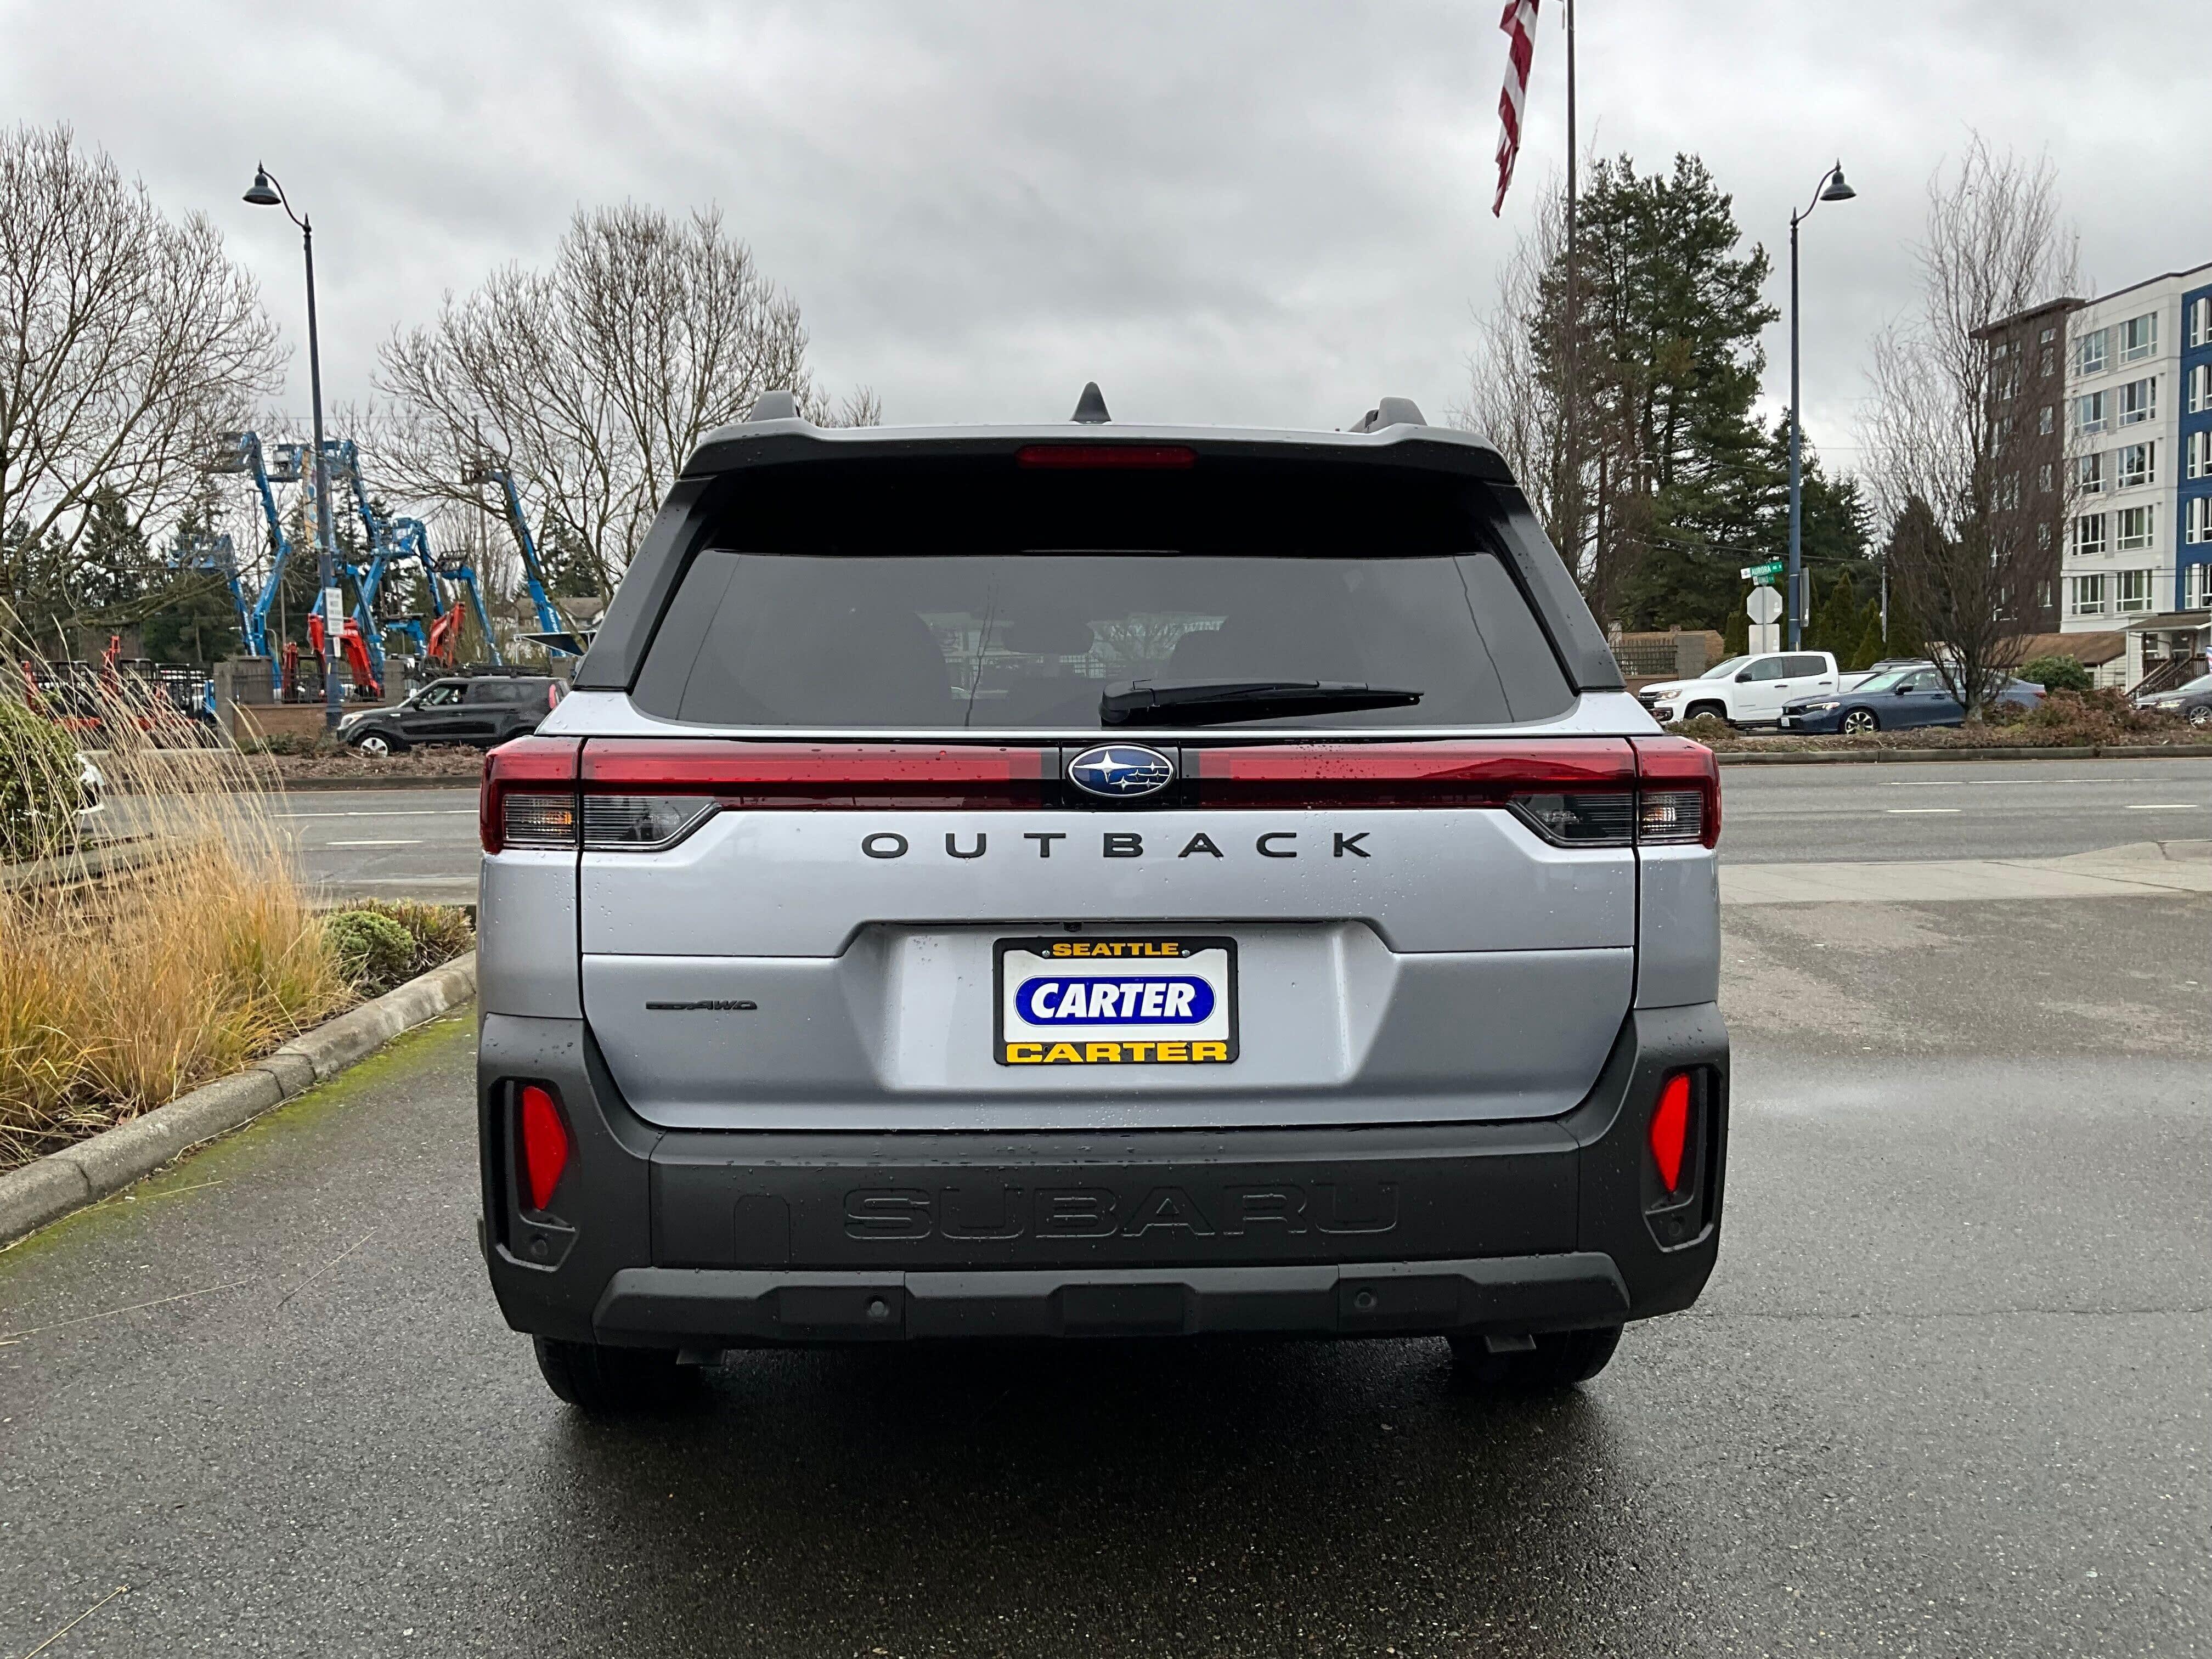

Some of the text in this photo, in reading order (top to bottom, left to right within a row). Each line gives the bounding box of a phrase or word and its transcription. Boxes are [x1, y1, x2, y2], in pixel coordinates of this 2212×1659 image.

[1752, 565, 1771, 575] AURORA
[860, 831, 1372, 859] OUTBACK
[1052, 943, 1179, 957] SEATTLE
[686, 1000, 758, 1010] AWD
[1031, 983, 1197, 1019] CARTER
[1006, 1042, 1228, 1063] CARTER
[843, 1183, 1399, 1240] SUBARU
